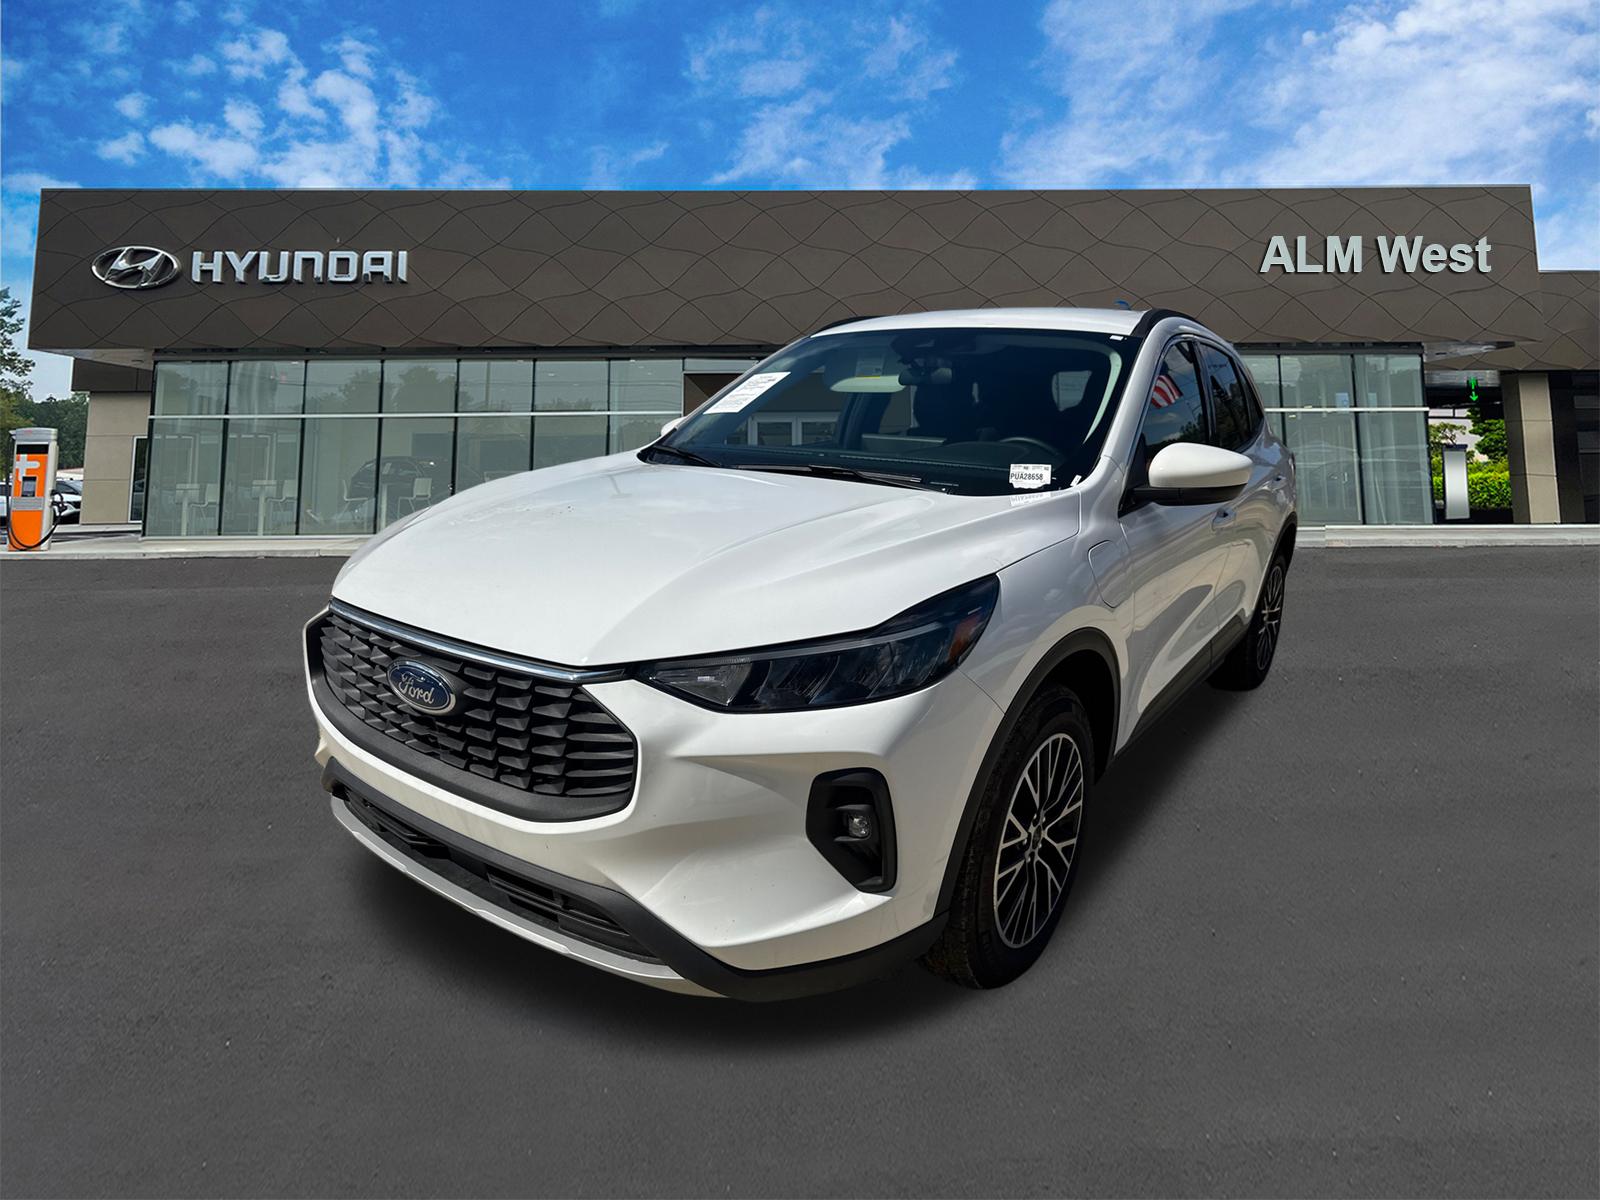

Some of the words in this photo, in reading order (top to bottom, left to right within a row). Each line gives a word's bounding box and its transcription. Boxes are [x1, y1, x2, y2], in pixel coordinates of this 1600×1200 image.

[191, 250, 408, 284] HYUNDAI
[1259, 235, 1363, 273] ALM
[1377, 235, 1492, 273] West
[398, 670, 435, 705] Ford
